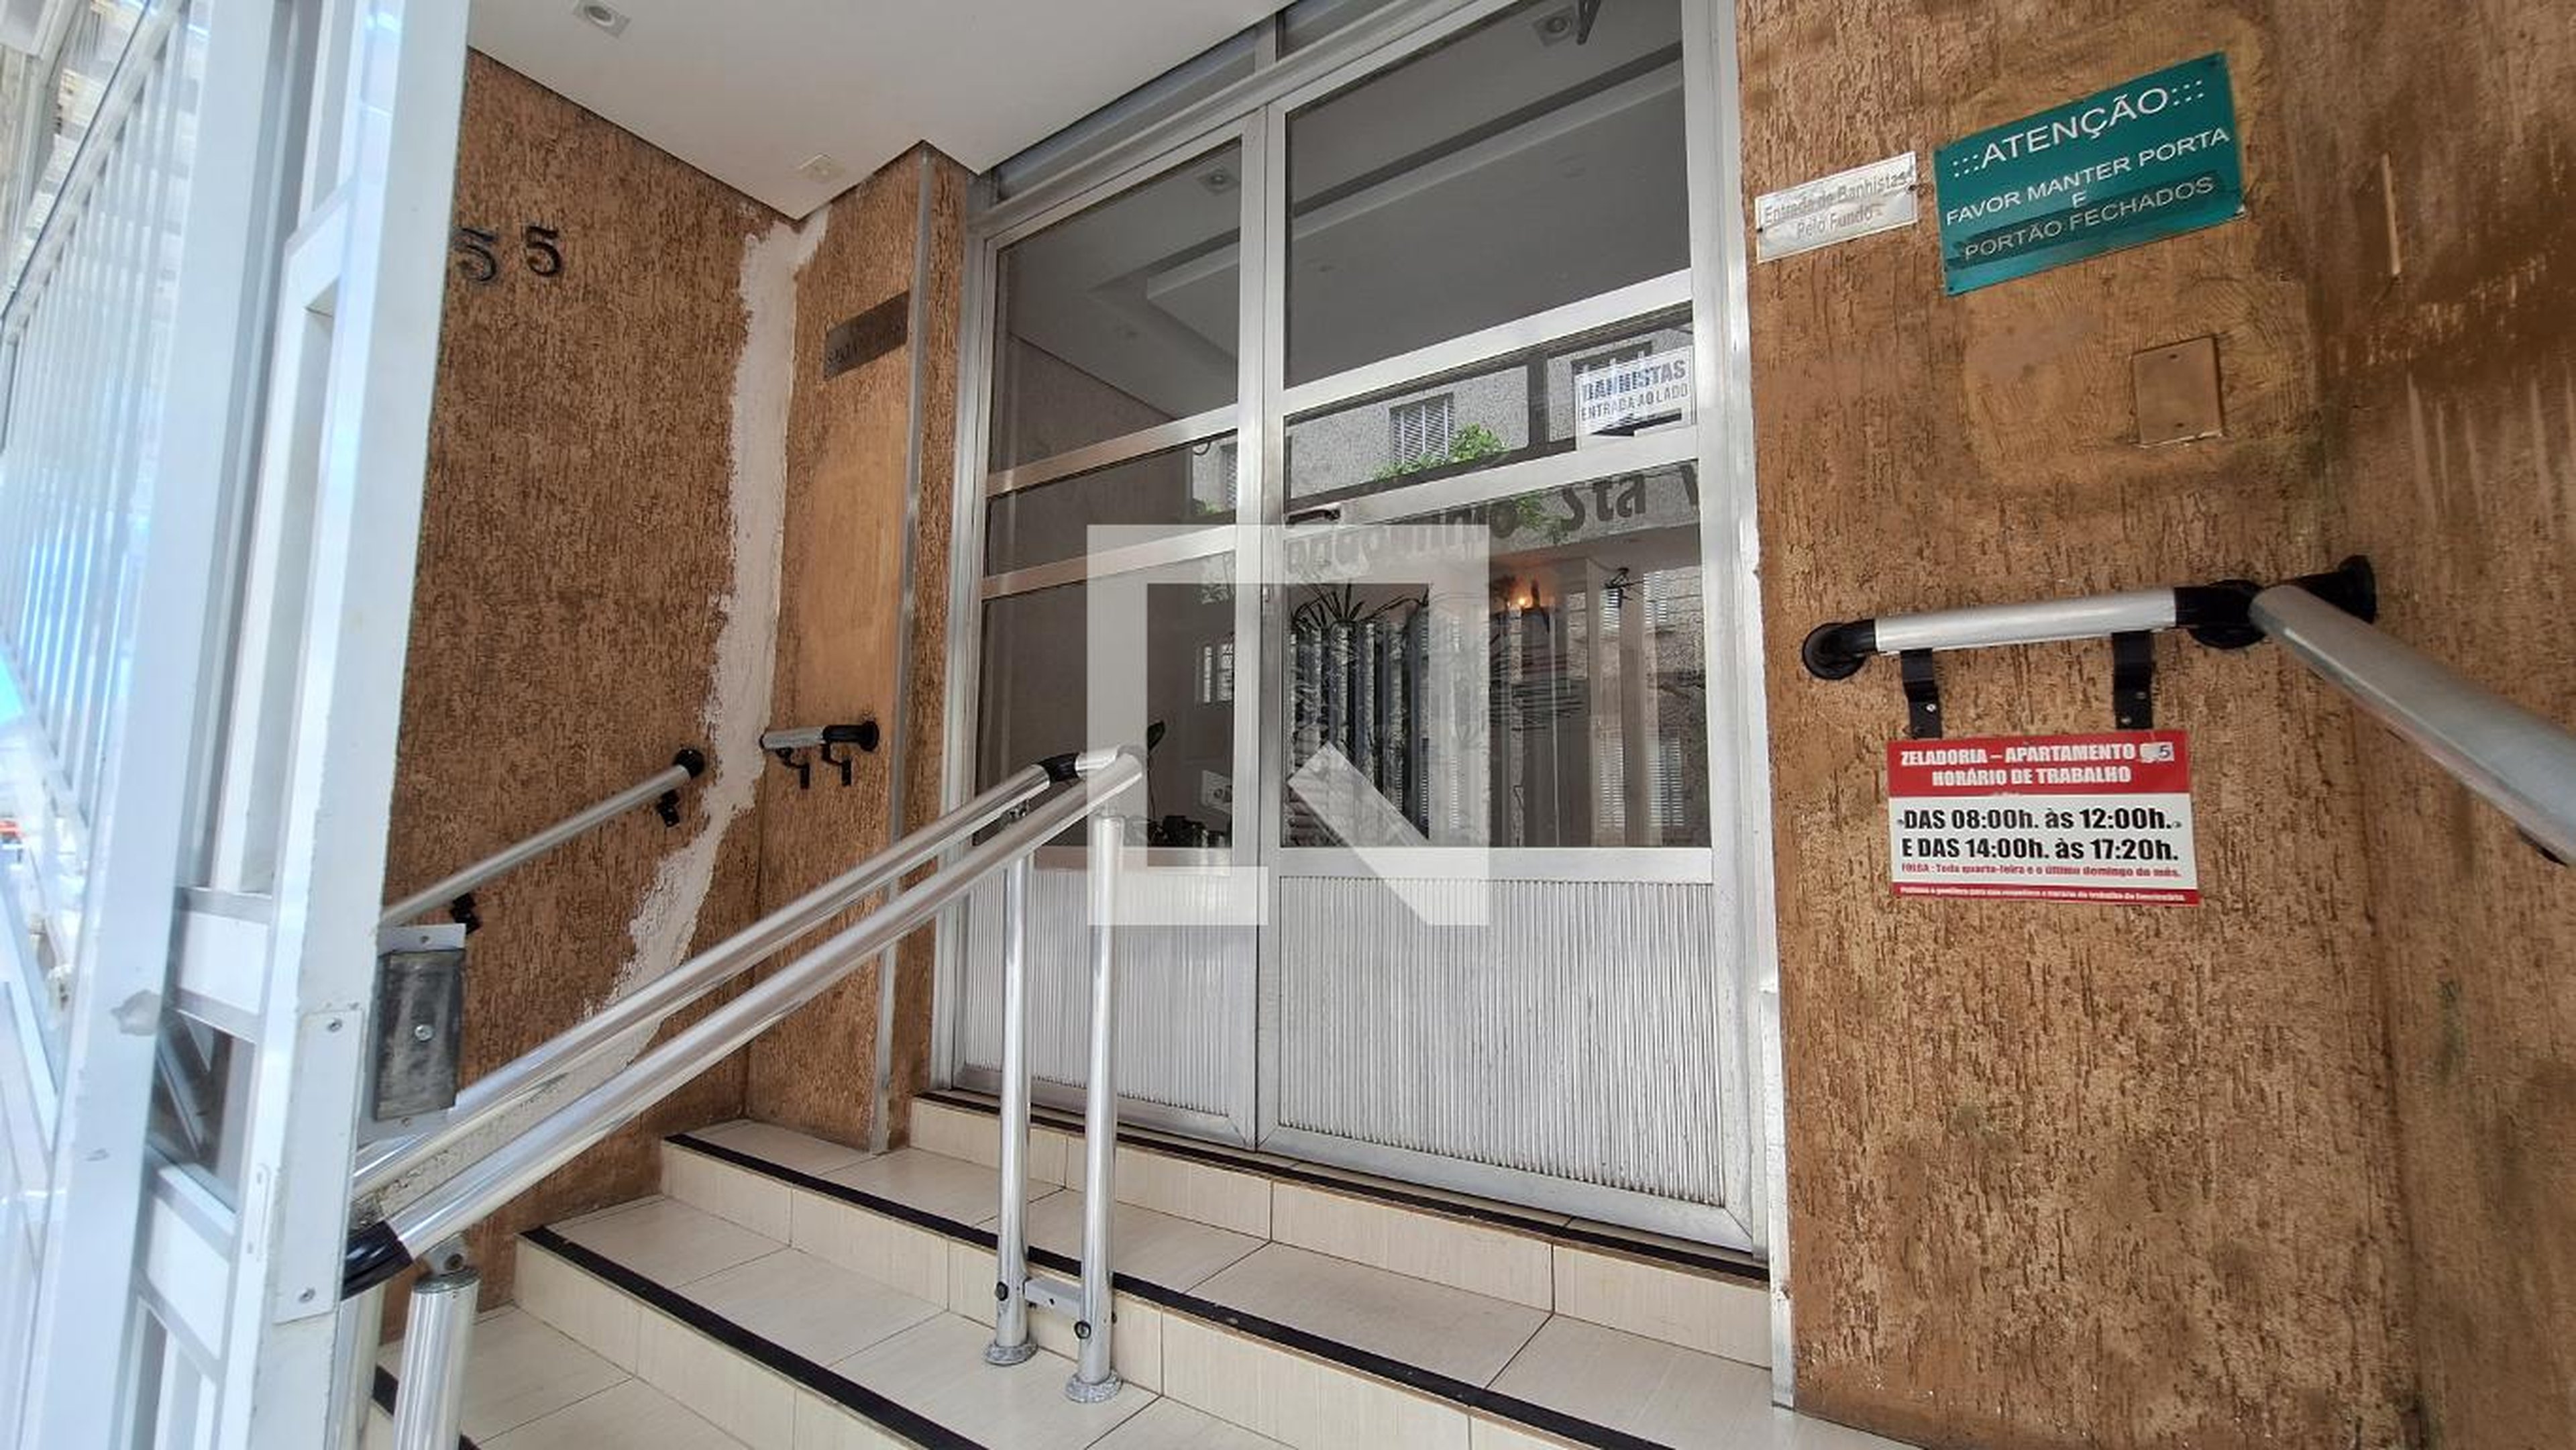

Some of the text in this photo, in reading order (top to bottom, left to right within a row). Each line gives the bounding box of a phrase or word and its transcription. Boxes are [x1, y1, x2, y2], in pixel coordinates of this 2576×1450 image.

[1945, 127, 2230, 225] FAVOR MANTER PORTA
[1764, 197, 1813, 224] Entrada
[1837, 170, 1907, 201] Banhistas
[2072, 192, 2088, 209] E
[1796, 215, 1825, 239] Pelo
[1965, 176, 2214, 260] PORTÃO FECHADOS
[1900, 748, 1988, 766] ZELADORIA
[2004, 743, 2135, 764] APARTAMENTO
[1931, 766, 2132, 786] HORÁRIO DE TRABALHO
[1904, 807, 2172, 829] DAS 08:00h. às 12:00h.
[1901, 837, 2179, 861] E DAS 14:00h. às 17:20h.
